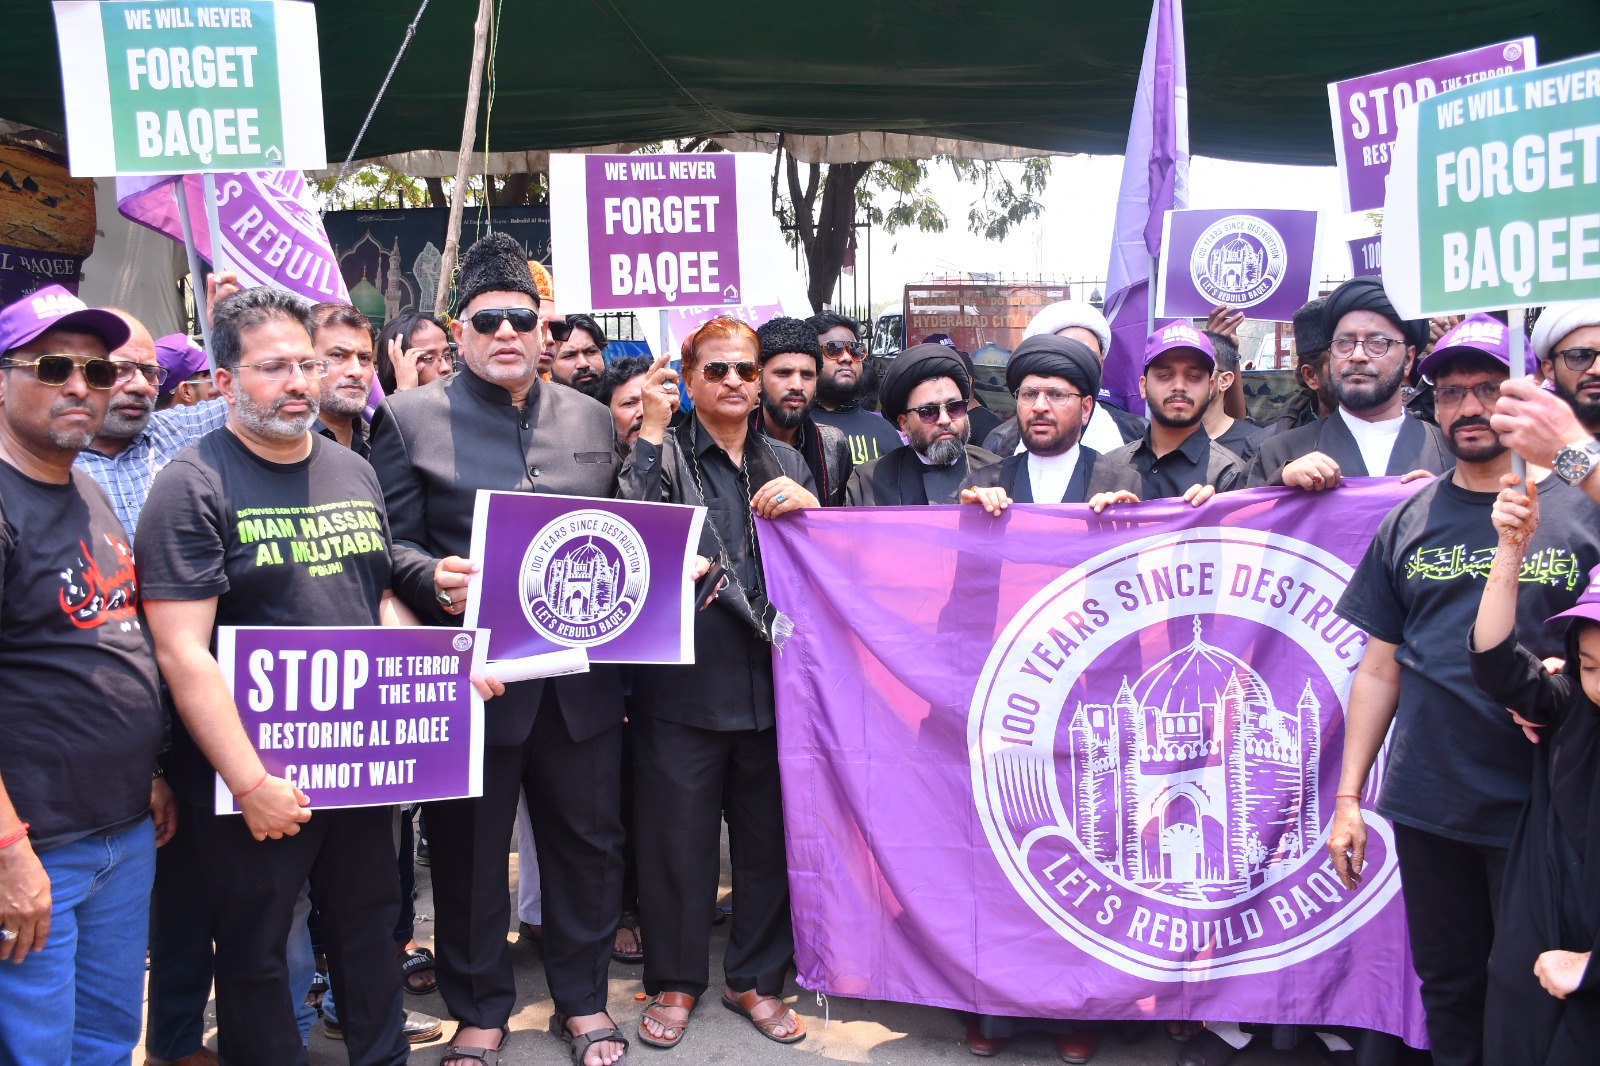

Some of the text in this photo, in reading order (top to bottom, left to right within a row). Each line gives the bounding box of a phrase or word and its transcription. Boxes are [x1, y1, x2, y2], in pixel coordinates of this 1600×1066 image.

[125, 7, 252, 30] WE WILL NEVER
[126, 46, 258, 90] FORGET
[1437, 101, 1464, 130] WE
[1468, 86, 1518, 121] WILL
[1525, 68, 1600, 110] NEVER
[136, 108, 261, 164] BAQEE
[605, 161, 716, 181] WE WILL NEVER
[1436, 124, 1600, 207] FORGET
[604, 196, 719, 235] FORGET
[1198, 221, 1280, 259] 100 YEARS SINCE DESTRUCTION
[1361, 241, 1381, 270] 100
[1443, 214, 1600, 297] BAQEE
[0, 253, 75, 278] L BAQEE
[610, 251, 720, 302] BAQEE
[915, 298, 951, 306] POLICE
[991, 297, 1004, 306] DO
[1202, 280, 1269, 303] LET'S REBUILD BAQEE
[913, 316, 988, 328] HYDERABAD
[993, 315, 1019, 328] CITY
[237, 508, 275, 518] DEPRIVED
[275, 507, 291, 515] SON
[292, 507, 302, 515] OF
[302, 506, 316, 514] THE
[315, 501, 351, 513] PROPHET
[237, 518, 297, 543] IMAM
[531, 519, 641, 574] 100 YEARS SINCE DESTRUCTION
[256, 532, 383, 566] AL MUJTABA
[308, 562, 343, 577] (PBUH)
[535, 605, 627, 638] LET'S REBUILD BAQEE
[1001, 562, 1368, 748] 100 YEARS SINCE DESTRUC
[248, 648, 460, 712] STOP THE TERROR
[379, 681, 457, 705] THE HATE
[259, 716, 450, 750] RESTORING AL BAQEE
[285, 759, 416, 790] CANNOT WAIT
[1041, 850, 1369, 954] LET'S REBUILD BAQE
[402, 956, 427, 971] PUMA
